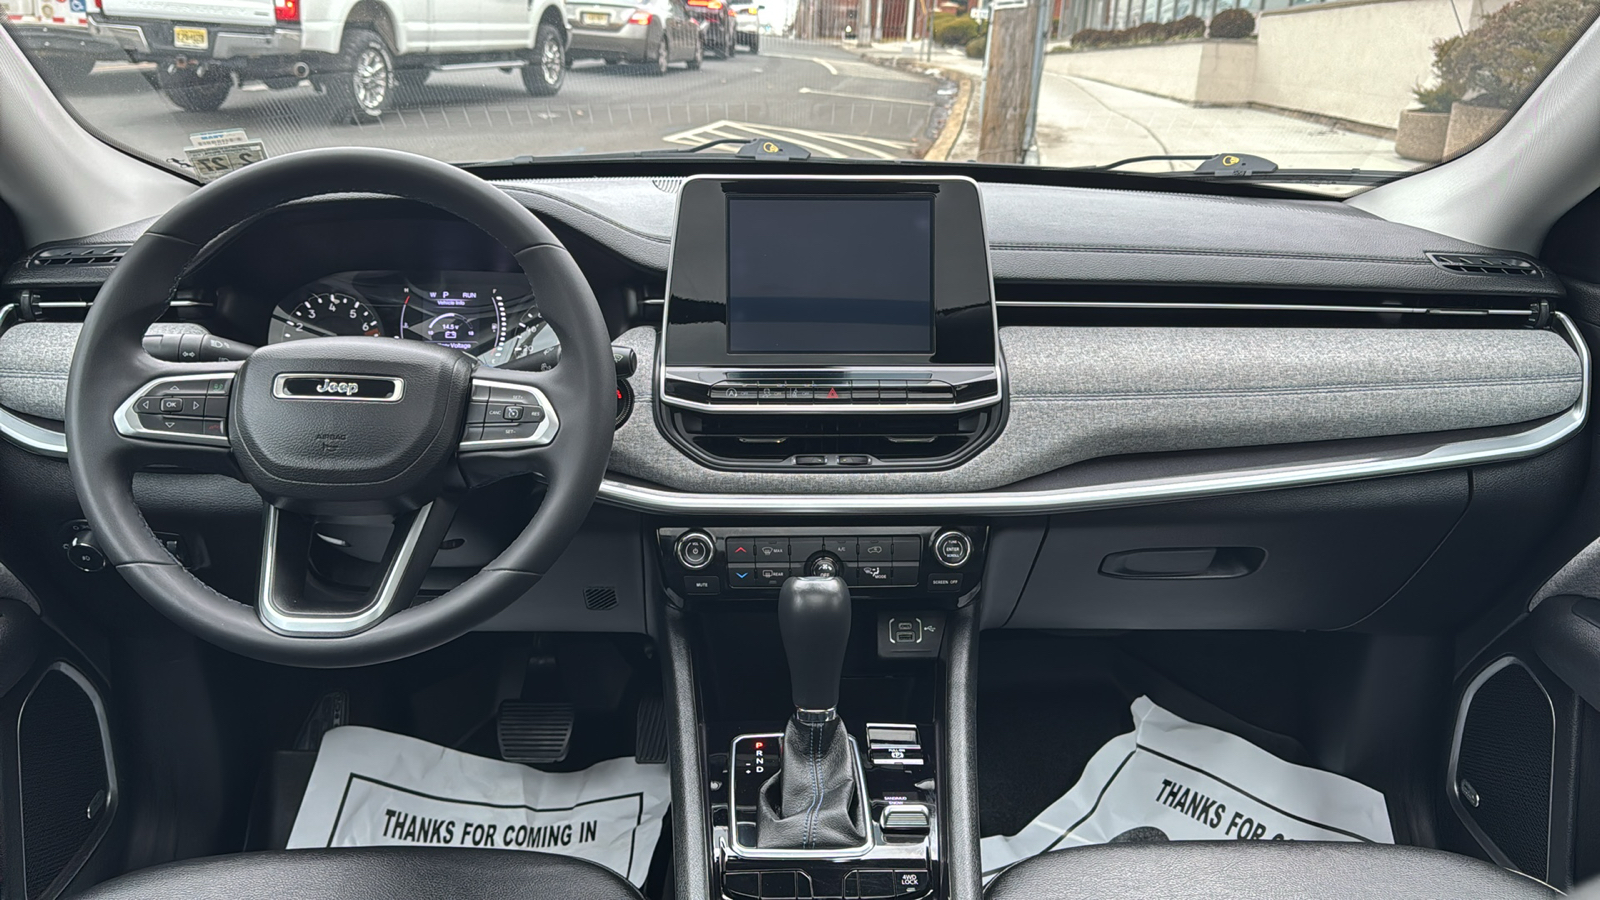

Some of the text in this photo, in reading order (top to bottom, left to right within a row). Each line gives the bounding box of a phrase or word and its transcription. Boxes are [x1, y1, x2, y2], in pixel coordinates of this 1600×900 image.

[329, 304, 336, 312] 4
[308, 309, 316, 319] 3
[350, 309, 357, 318] 5
[296, 322, 304, 332] 2
[362, 323, 369, 332] 6
[316, 378, 359, 396] Jeep
[1154, 779, 1267, 840] THANKS FOR
[382, 809, 598, 848] THANKS FOR COMING IN
